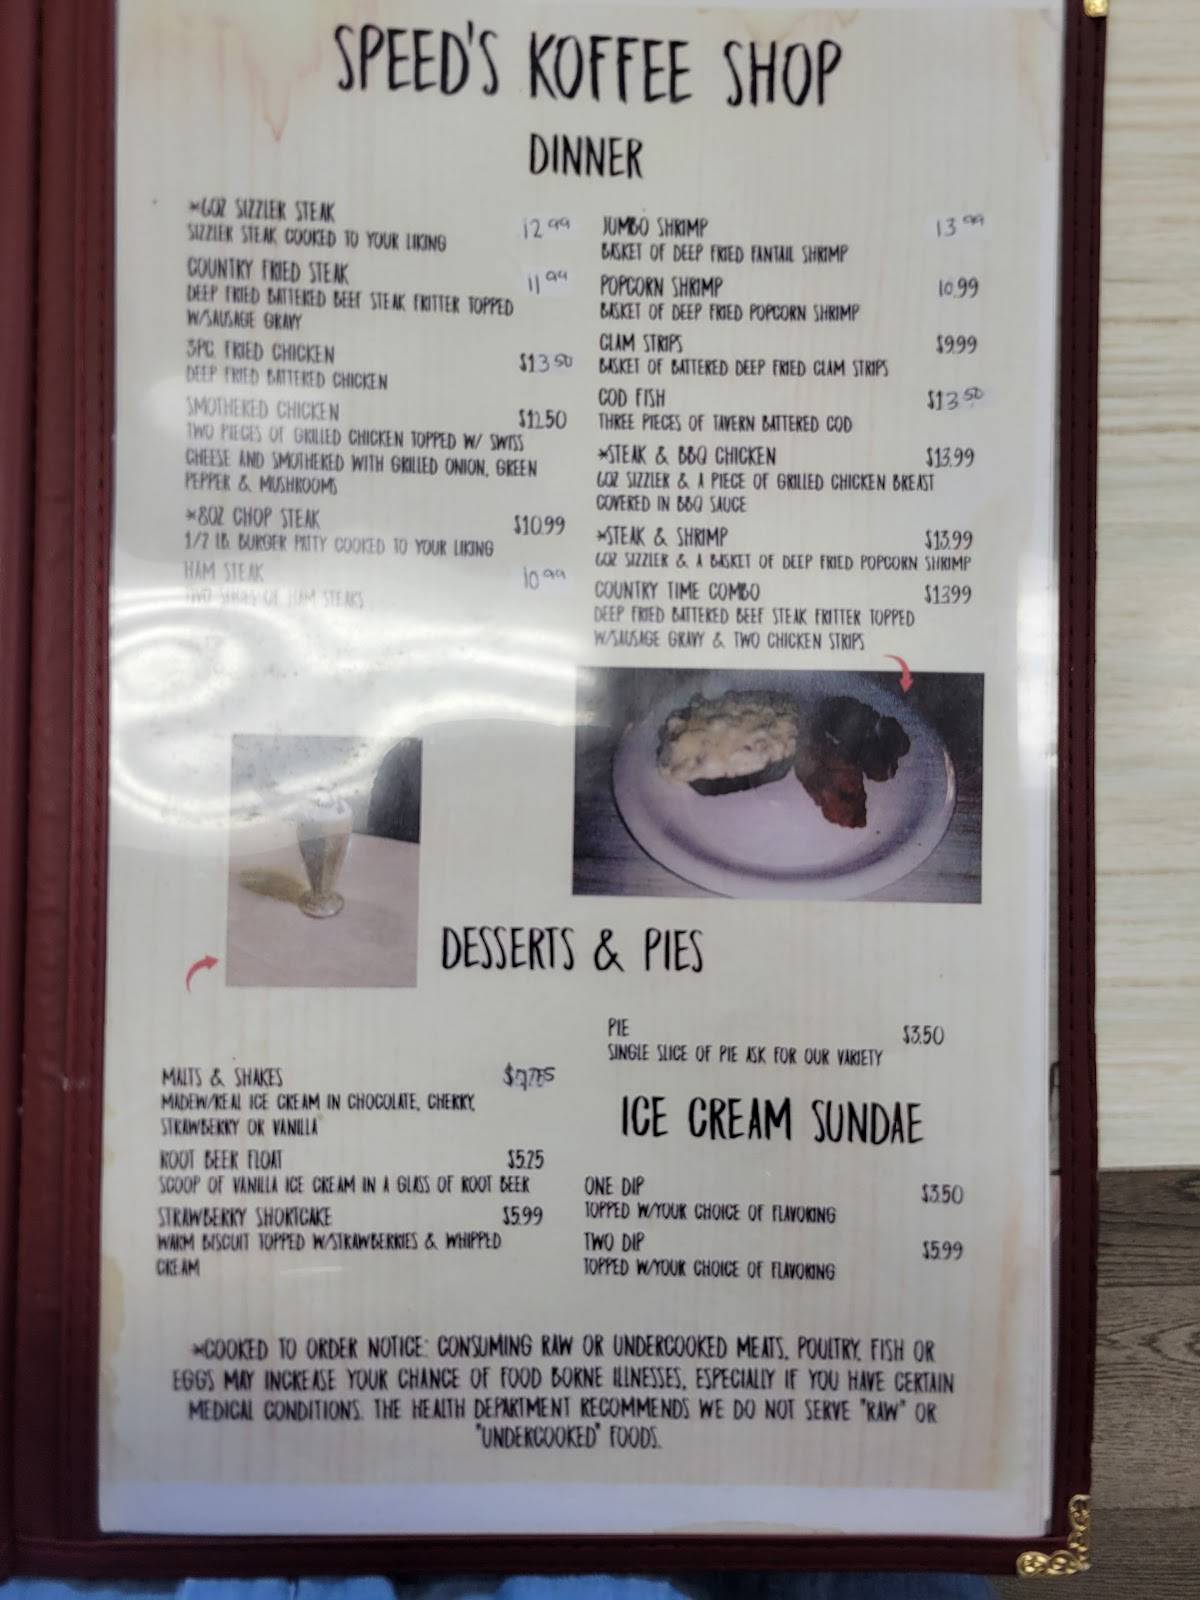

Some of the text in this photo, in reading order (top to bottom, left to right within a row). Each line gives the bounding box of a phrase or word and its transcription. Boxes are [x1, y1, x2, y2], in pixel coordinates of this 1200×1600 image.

[334, 21, 842, 107] SPEED'S KOFFEE SHOP
[530, 133, 643, 178] DINNER
[235, 198, 335, 223] SIZZLER STEAK
[603, 216, 708, 237] JUMBO SHRIMP
[601, 242, 848, 264] BASKET OF DEEP FRIED FANTAIL SHRIMP
[187, 256, 349, 285] COUNTRY FRIED STEAK
[601, 274, 723, 298] POPCORN SHRIMP
[224, 340, 335, 364] FRIED CHICKEN
[600, 333, 683, 353] CLAM STRIPS
[936, 334, 978, 354] $9.99
[599, 357, 888, 377] BASKET OF BATTERED DEEP FRIED CLAM STRIPS
[598, 387, 665, 408] COD FISH
[186, 396, 339, 422] SMOTHERED CHICKEN
[519, 409, 567, 429] $12.50
[348, 429, 403, 448] CHICKEN
[411, 430, 456, 450] TOPPED
[490, 434, 524, 452] SWISS
[185, 448, 230, 467] CHEESE
[239, 449, 264, 469] AND
[272, 451, 344, 472] SMOTHERED
[351, 454, 384, 472] WITH
[391, 455, 438, 475] GRILLED
[496, 459, 537, 477] GREEN
[678, 445, 776, 466] BBQ CHICKEN
[926, 447, 975, 468] $13.99
[184, 471, 337, 495] PEPPER MUSHROOMS
[711, 472, 934, 491] PIECE OF GRILLED CHICKEN BREAST
[232, 506, 320, 529] CHOP STEAK
[514, 515, 565, 535] $10.99
[677, 527, 728, 547] SHRIMP
[925, 530, 973, 550] $13.99
[183, 560, 264, 583] HAM STEAK
[595, 580, 760, 601] COUNTRY TIME COMBO
[924, 584, 972, 604] $13.99
[442, 926, 703, 973] DESSERTS & PIES
[608, 1018, 629, 1037] PIE
[903, 1025, 944, 1045] $3.50
[608, 1043, 883, 1066] SINGLE SLICE OF PIE ASK FOR OUR VARIETY
[162, 1067, 283, 1088] MALTS SHAKES
[249, 1093, 269, 1111] ICE
[277, 1093, 320, 1110] CREAM
[327, 1094, 340, 1110] IN
[622, 1096, 923, 1145] ICE CREAM SUNDAE
[160, 1149, 282, 1171] ROOT BEER FLOAT
[508, 1149, 544, 1169] $5.25
[585, 1176, 645, 1196] ONE DIP
[921, 1184, 964, 1205] $3.50
[158, 1206, 331, 1228] STRAWBERRY SHORTCAKE
[503, 1206, 543, 1226] $5.99
[585, 1201, 630, 1219] TOPPED
[694, 1203, 740, 1221] CHOICE
[748, 1204, 764, 1222] OF
[772, 1205, 836, 1224] FLAVORING
[157, 1233, 194, 1252] WARM
[202, 1232, 249, 1252] BISCUIT
[258, 1232, 305, 1251] TOPPED
[446, 1231, 501, 1249] WHIPPED
[584, 1232, 645, 1252] TWO DIP
[923, 1240, 963, 1260] $5.99
[278, 1337, 297, 1360] TO
[306, 1337, 358, 1360] ORDER
[437, 1334, 532, 1358] CONSUMING
[542, 1334, 573, 1356] RAW
[583, 1334, 604, 1357] OR
[613, 1334, 727, 1359] UNDERCOOKED
[871, 1338, 904, 1362] FISH
[913, 1340, 935, 1363] OR
[172, 1369, 215, 1392] EGGS
[224, 1369, 254, 1391] MAY
[264, 1369, 336, 1392] INCREASE
[346, 1368, 388, 1391] YOUR
[398, 1367, 459, 1390] CHANCE
[470, 1367, 490, 1389] OF
[501, 1366, 542, 1389] FOOD
[551, 1366, 602, 1388] BORNE
[696, 1367, 775, 1390] ESPECIALLY
[785, 1368, 798, 1390] IF
[808, 1368, 839, 1391] YOU
[848, 1370, 884, 1392] HAVE
[894, 1372, 954, 1394] CERTAIN
[474, 1397, 570, 1419] DEPARTMENT
[580, 1396, 690, 1419] RECOMMENDS
[699, 1398, 723, 1419] WE
[733, 1399, 756, 1420] DO
[765, 1399, 795, 1420] NOT
[805, 1399, 850, 1421] SERVE
[915, 1402, 937, 1423] OR
